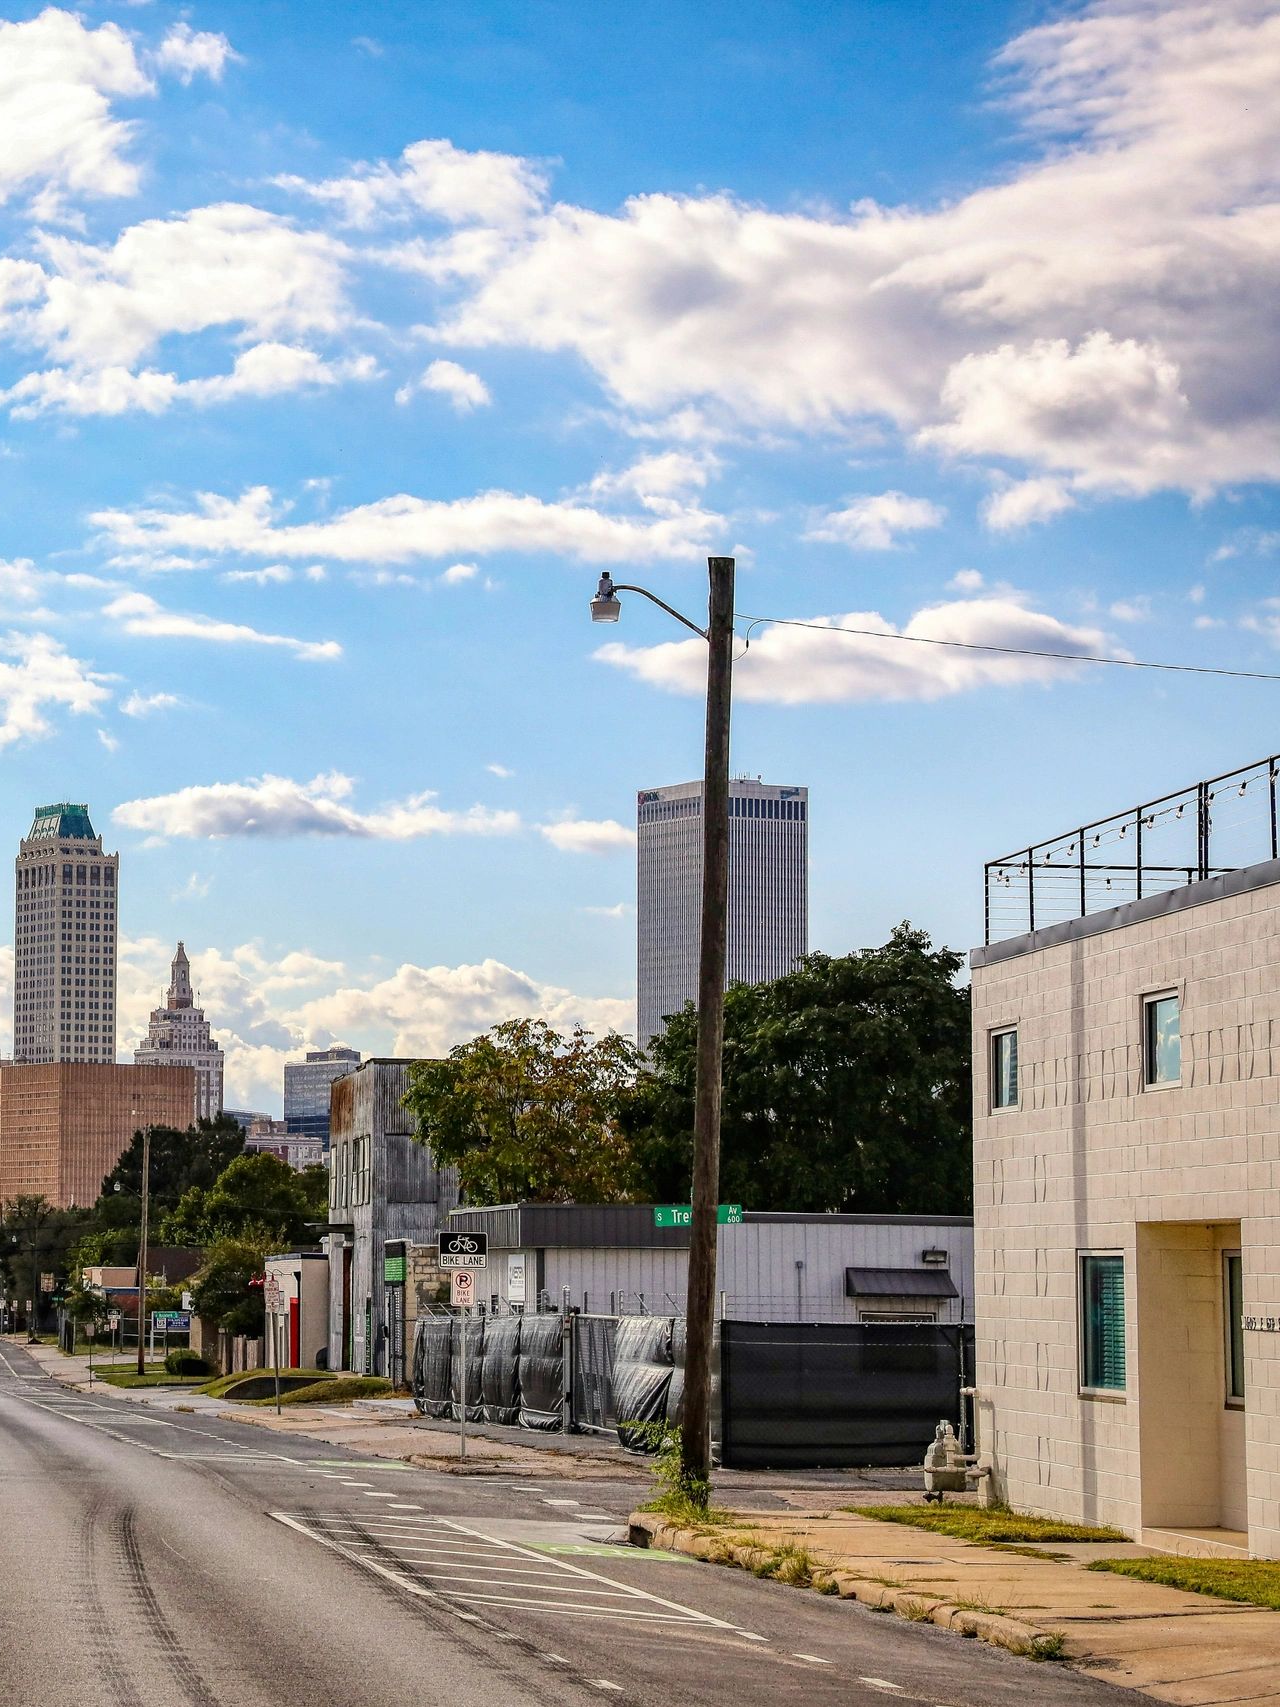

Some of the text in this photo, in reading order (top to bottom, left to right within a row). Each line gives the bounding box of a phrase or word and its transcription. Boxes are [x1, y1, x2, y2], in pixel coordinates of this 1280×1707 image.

[728, 1206, 737, 1214] Av
[442, 1256, 484, 1265] BIKE LANE
